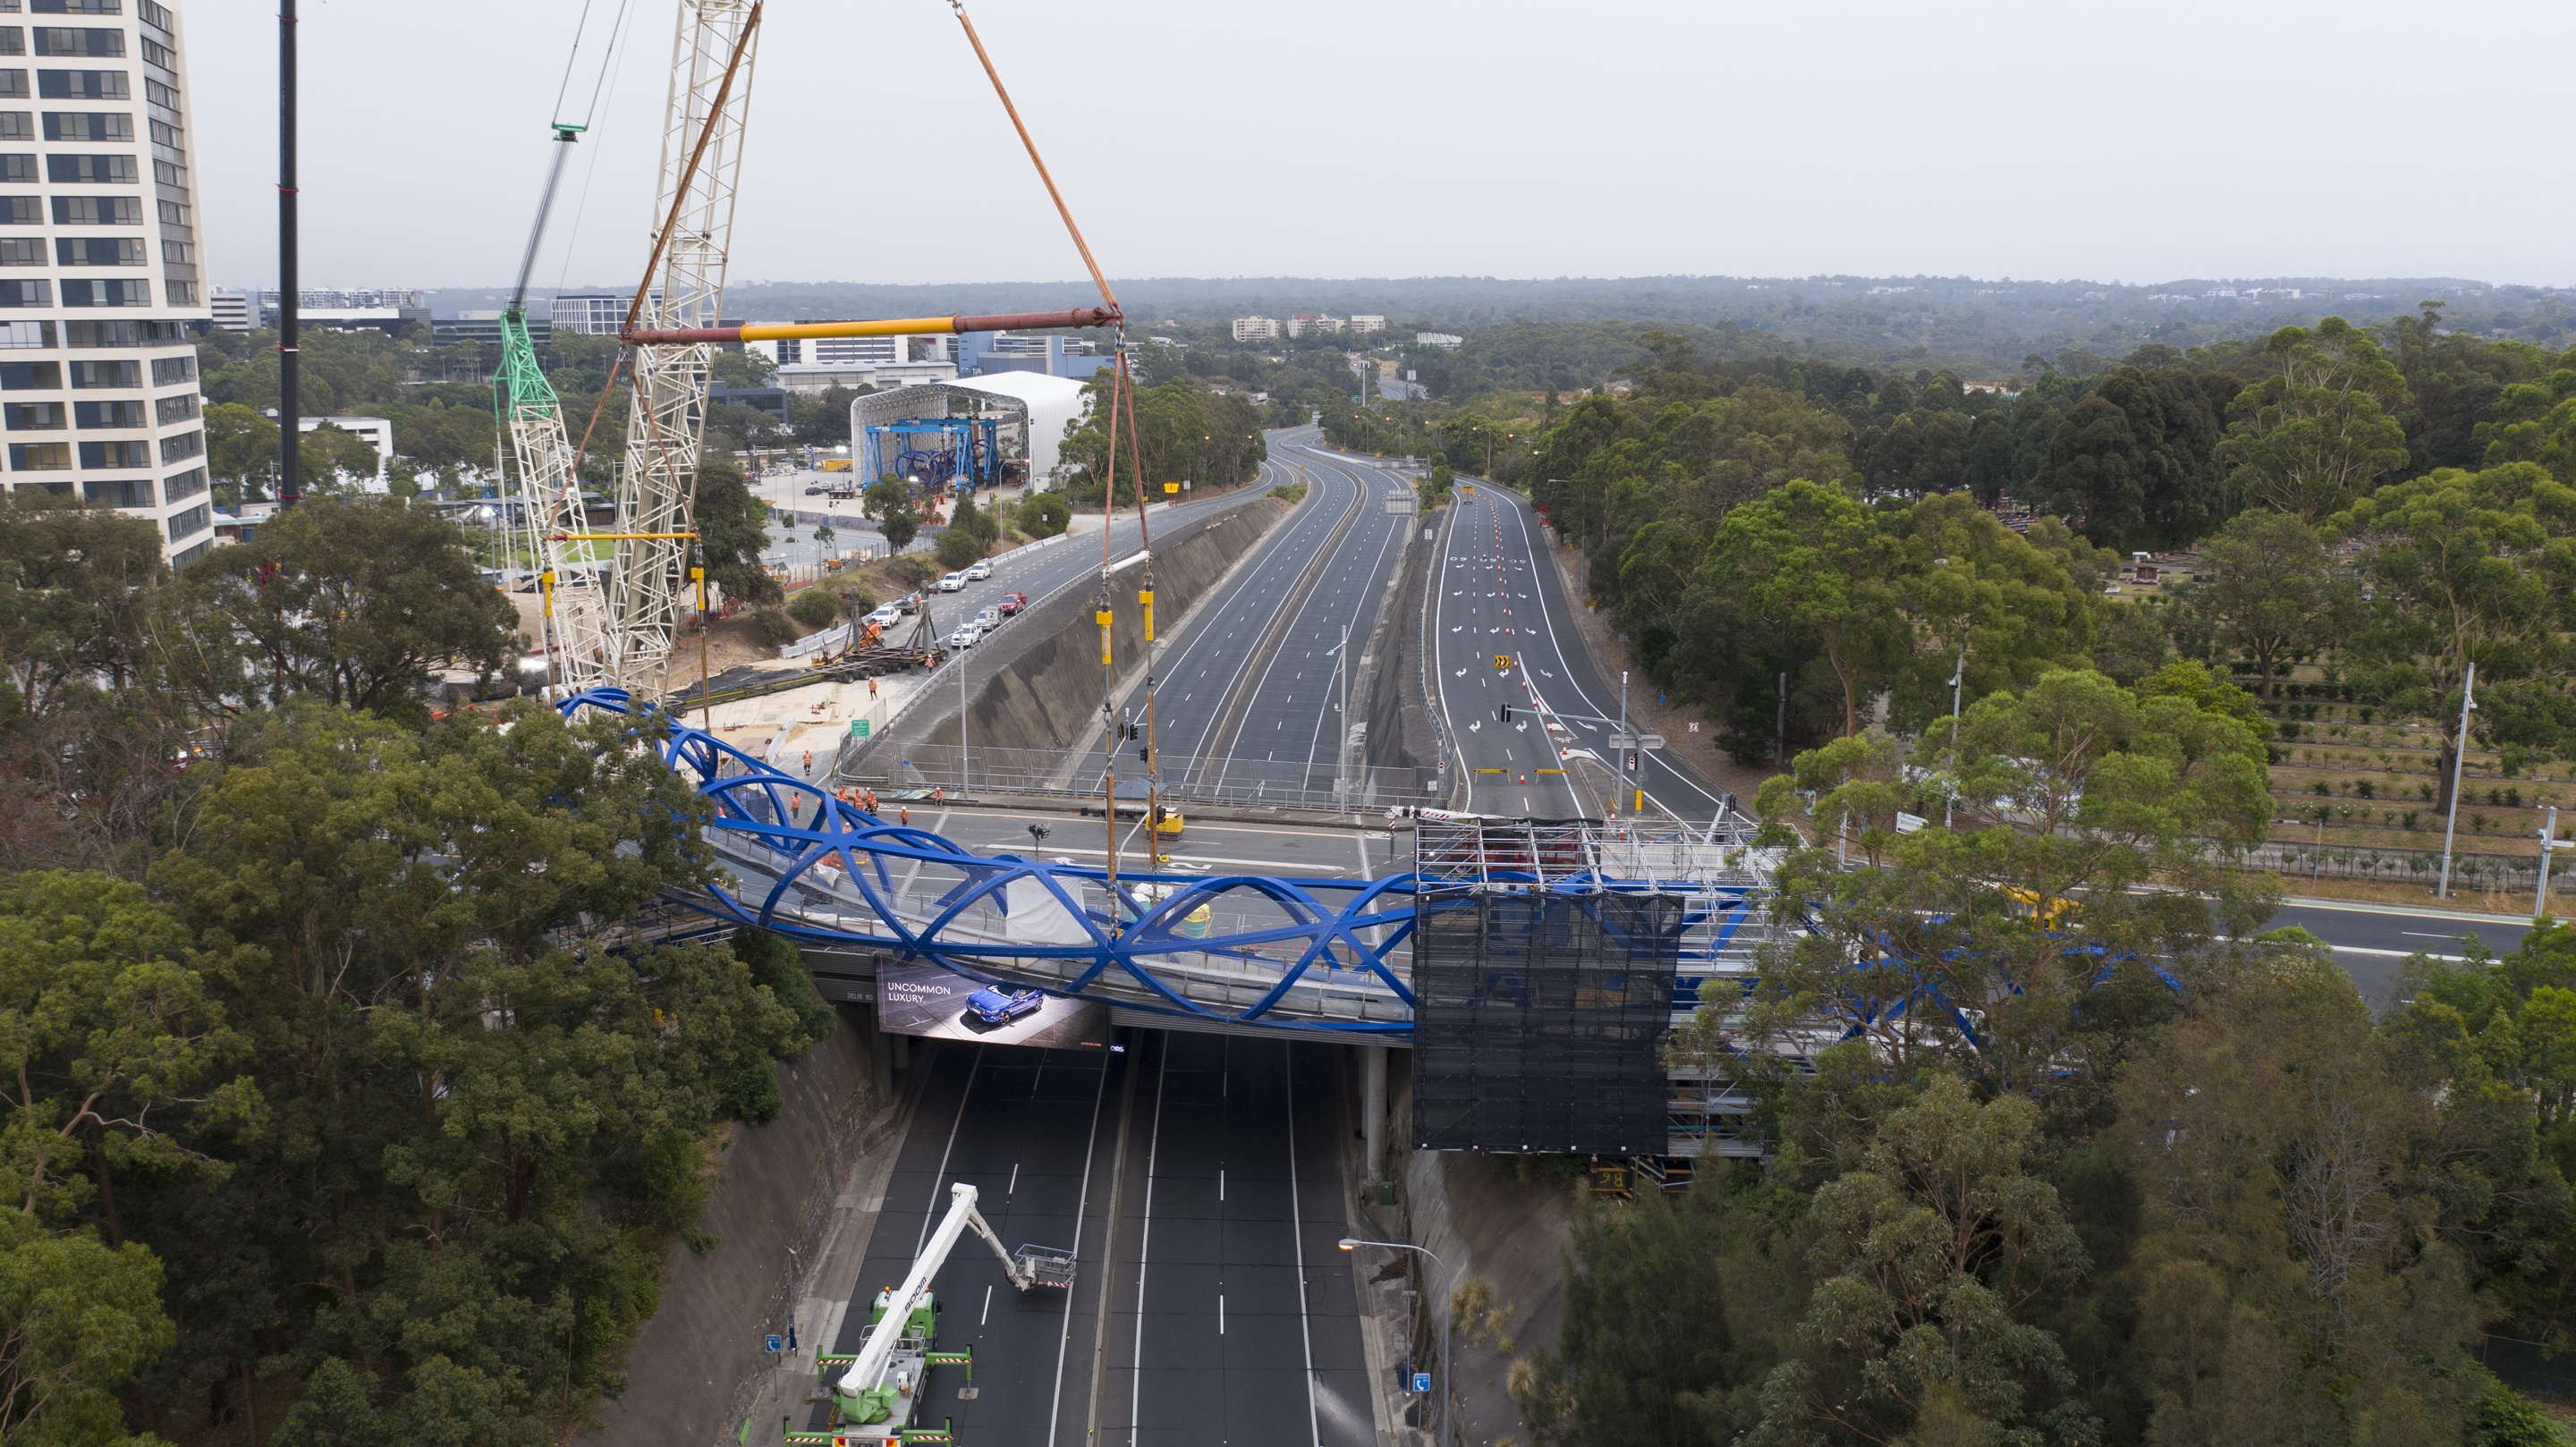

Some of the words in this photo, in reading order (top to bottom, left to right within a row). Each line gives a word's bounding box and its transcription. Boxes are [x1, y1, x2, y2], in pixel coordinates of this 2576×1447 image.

[887, 982, 951, 995] UNCOMMON
[847, 992, 863, 1000] DELHI
[888, 993, 926, 1003] LUXURY.
[904, 1276, 928, 1313] BOOM
